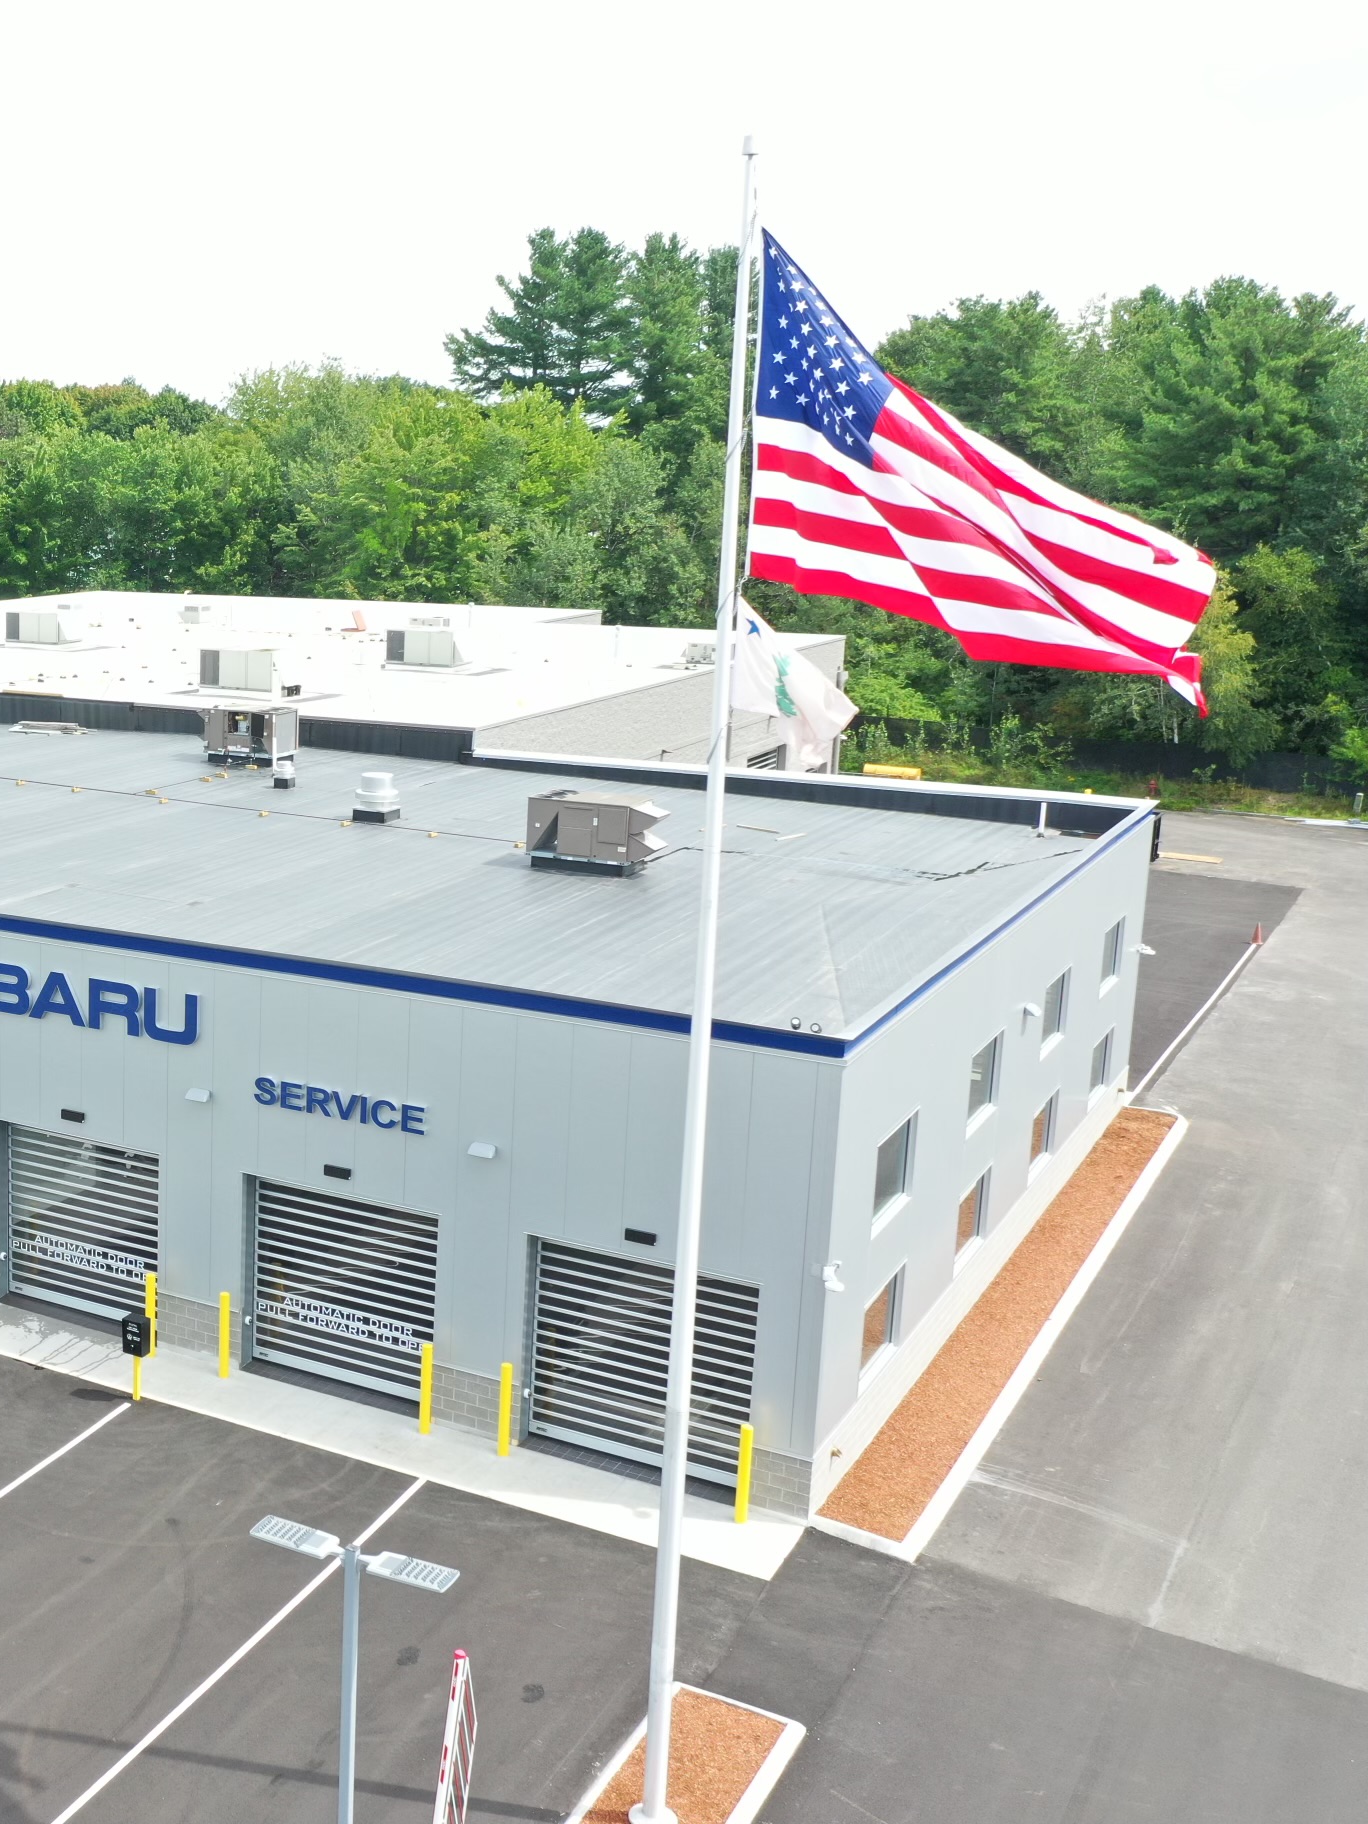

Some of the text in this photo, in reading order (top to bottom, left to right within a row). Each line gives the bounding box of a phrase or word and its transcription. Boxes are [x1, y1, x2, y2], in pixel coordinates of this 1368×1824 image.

[254, 1077, 428, 1136] SERVICE
[12, 1240, 43, 1256] PULL
[47, 1250, 106, 1271] FORWARD
[111, 1266, 127, 1277] TO
[34, 1235, 145, 1270] AUTOMATIC DOOR
[258, 1302, 293, 1319] PULL
[298, 1313, 368, 1338] FORWARD
[373, 1332, 392, 1344] TO
[283, 1297, 413, 1337] AUTOMATIC DOOR
